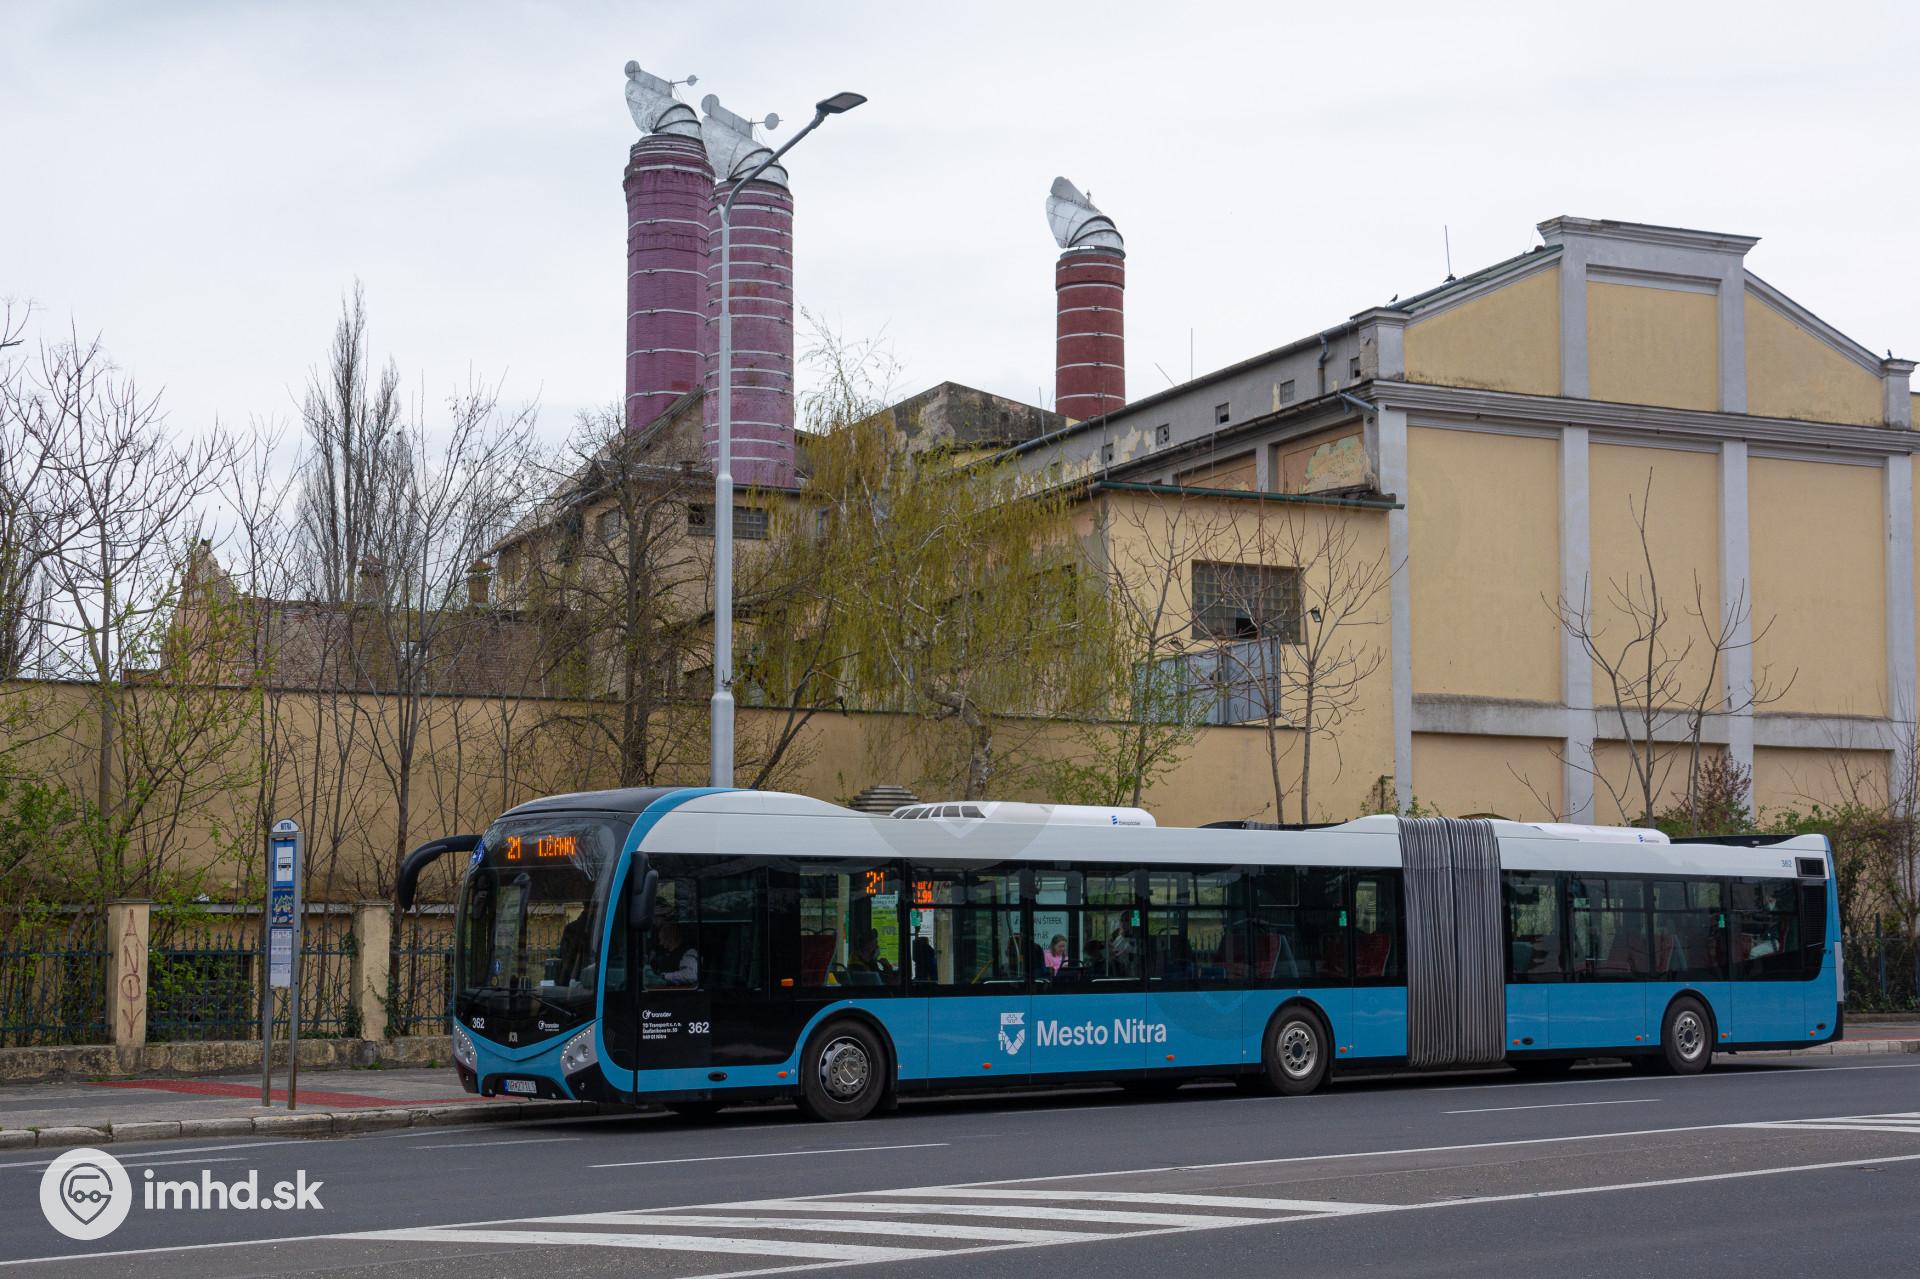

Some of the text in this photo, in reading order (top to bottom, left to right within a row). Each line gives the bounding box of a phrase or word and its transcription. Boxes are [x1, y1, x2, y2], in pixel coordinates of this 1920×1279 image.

[507, 836, 521, 860] 21
[866, 871, 885, 896] 21
[472, 1017, 485, 1030] 362
[688, 1021, 710, 1034] 362
[1036, 1018, 1167, 1047] Mesto Nitra
